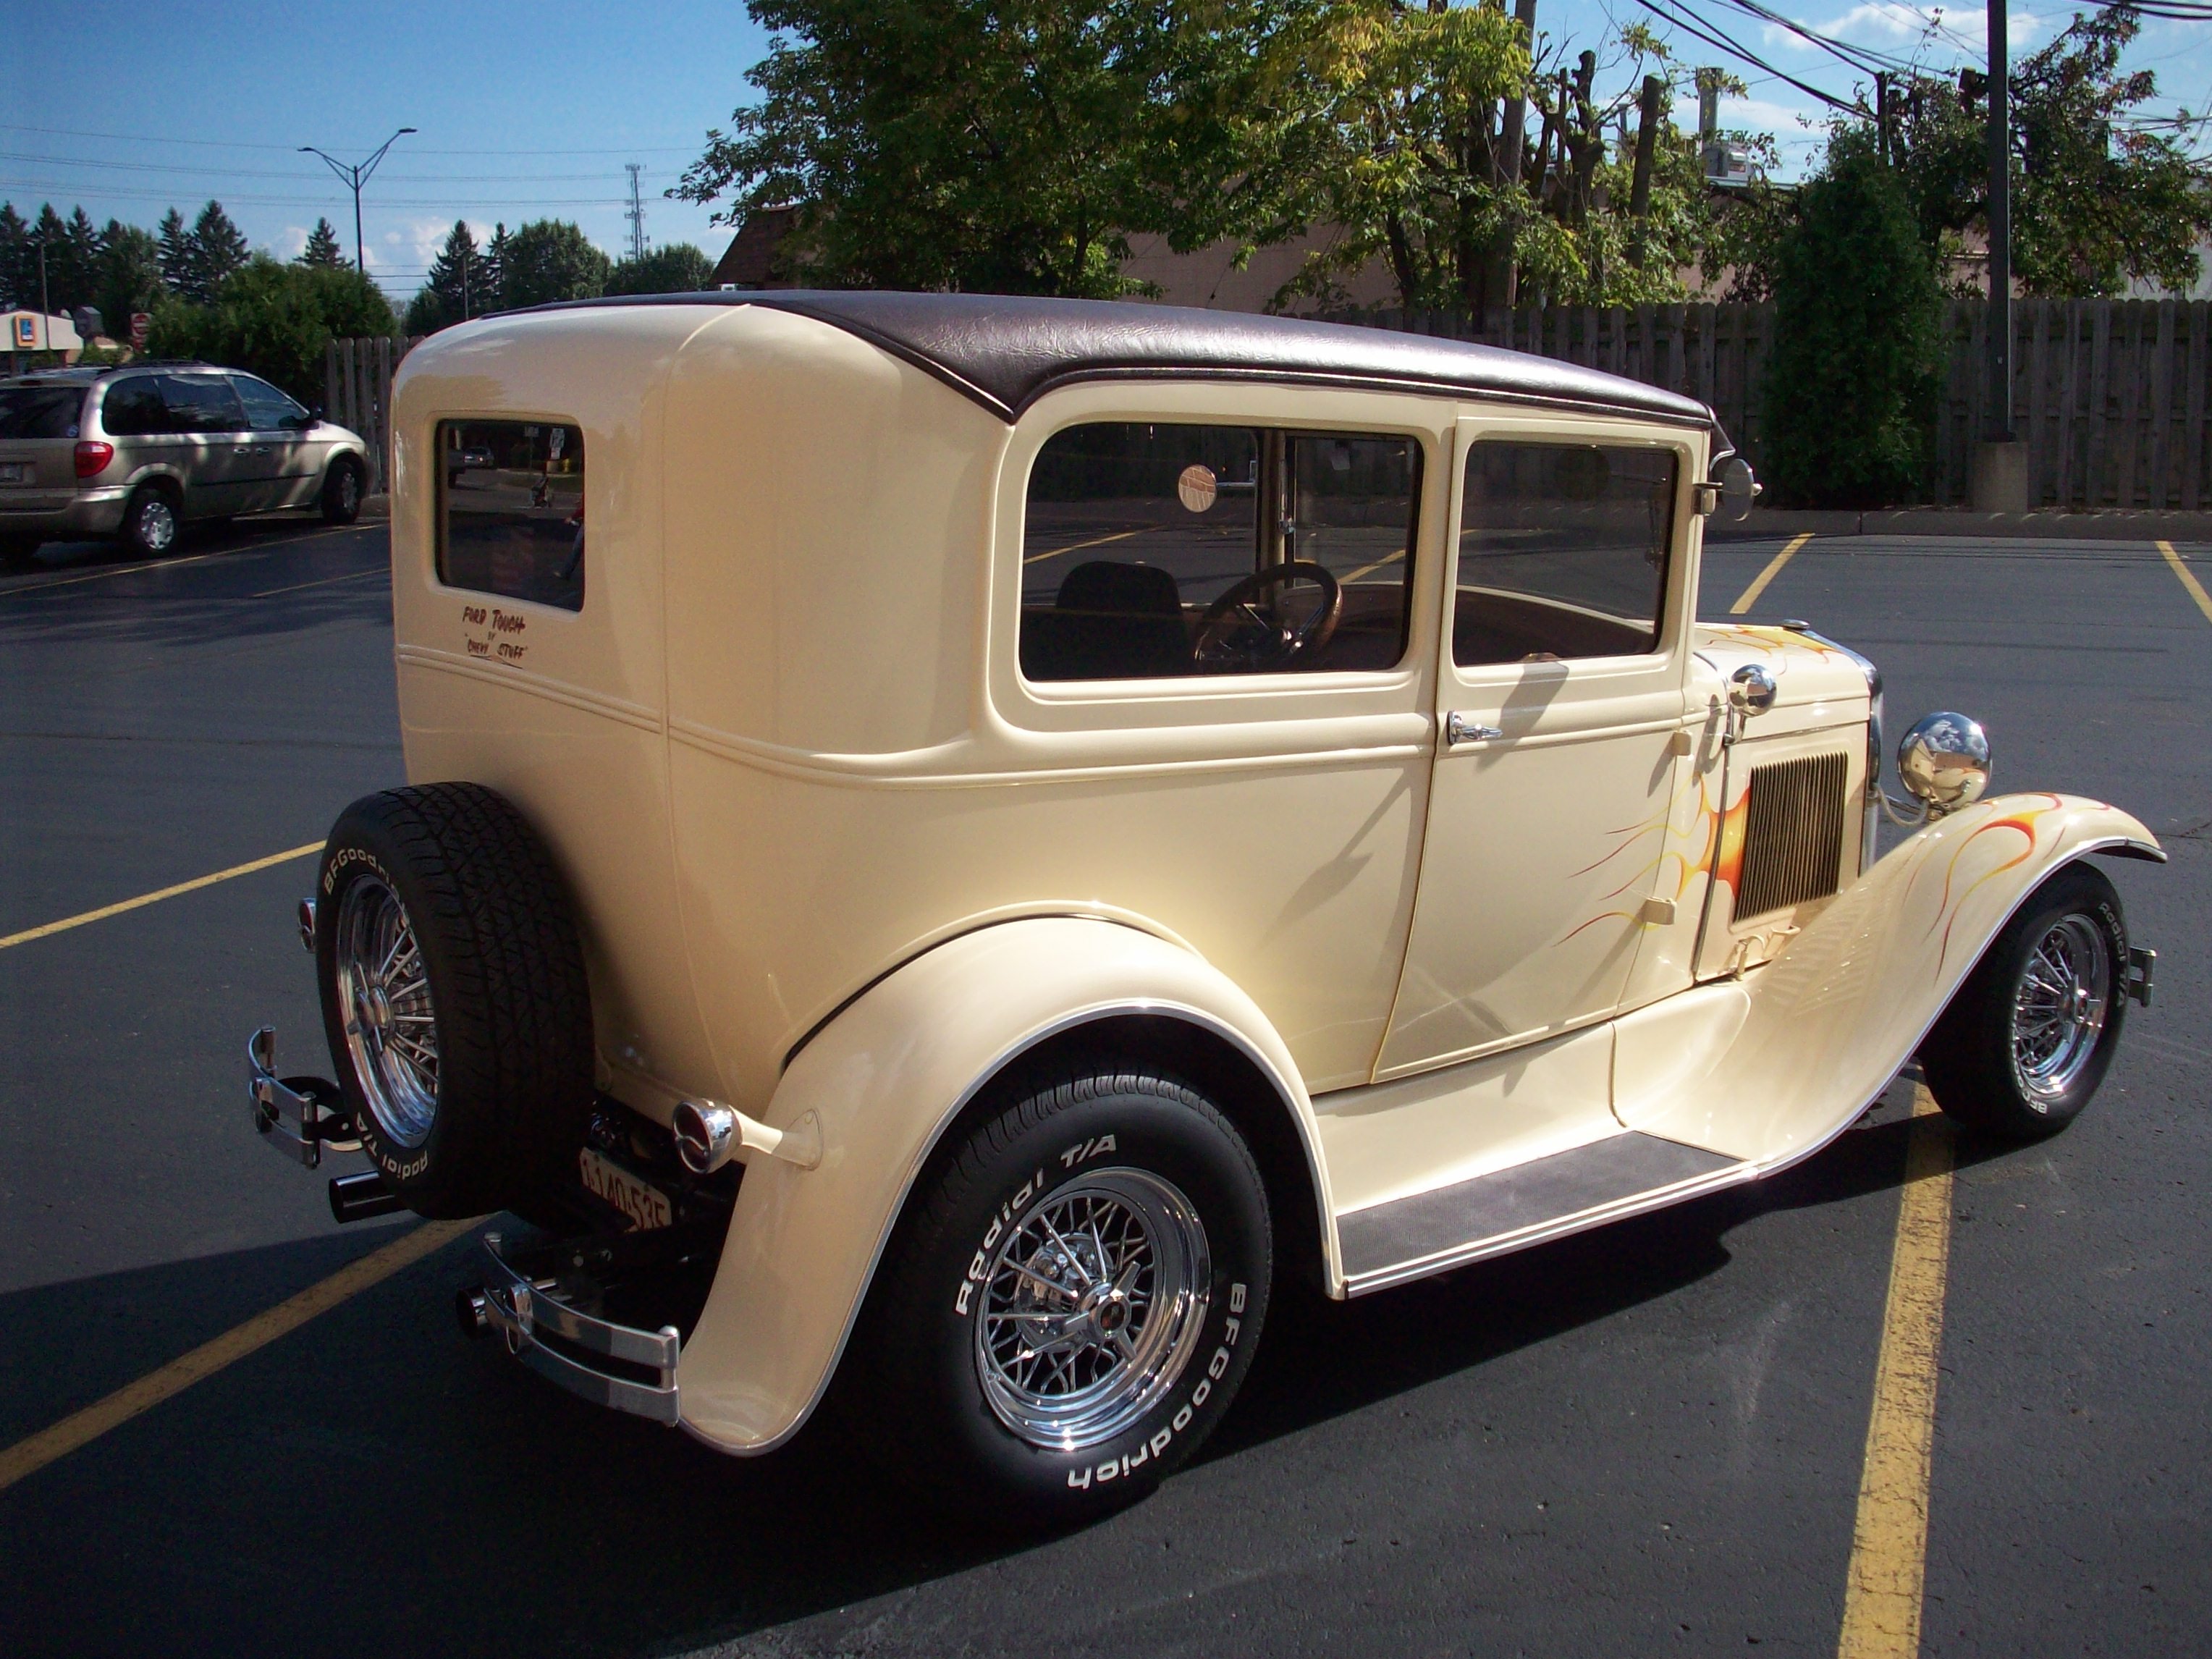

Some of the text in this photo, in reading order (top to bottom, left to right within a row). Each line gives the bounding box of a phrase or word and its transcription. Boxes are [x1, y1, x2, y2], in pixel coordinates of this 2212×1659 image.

[463, 607, 525, 635] FORD TOUGH
[382, 1150, 428, 1181] Radial
[955, 1134, 1117, 1315] Radial T/A
[1068, 1283, 1246, 1490] BFGoodrich
